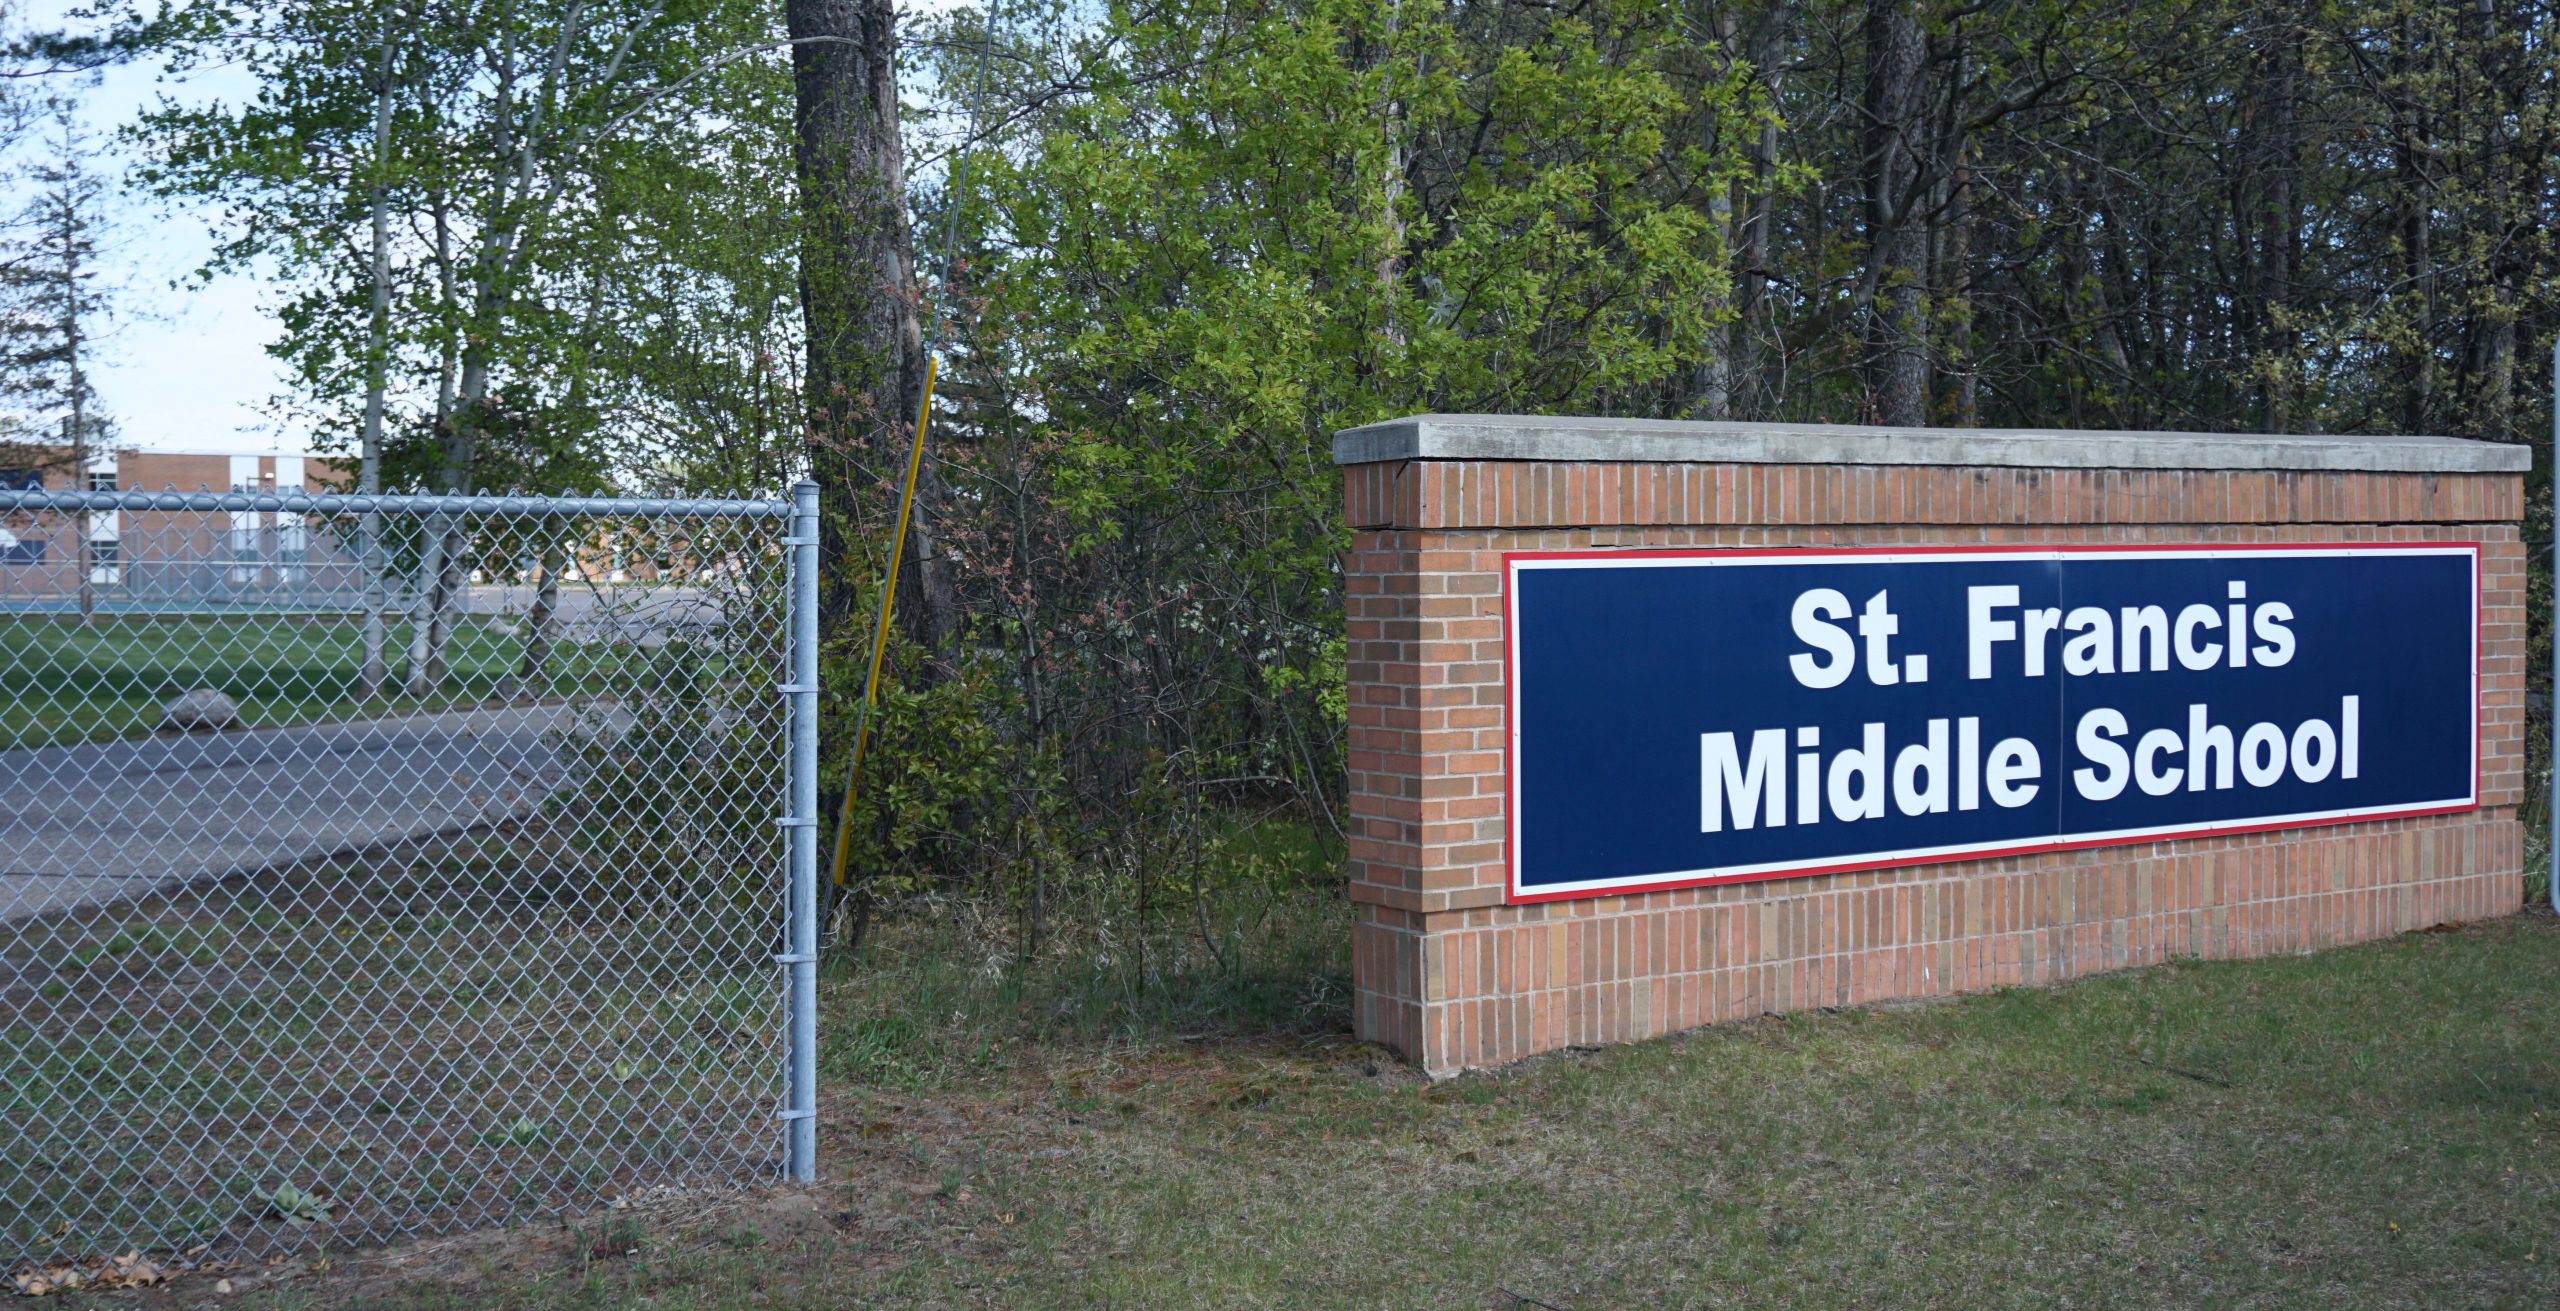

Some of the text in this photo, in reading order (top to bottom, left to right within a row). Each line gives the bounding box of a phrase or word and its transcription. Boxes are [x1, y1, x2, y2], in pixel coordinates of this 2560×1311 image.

[1789, 580, 2296, 689] St. Francis
[1701, 695, 2359, 833] Middle School
